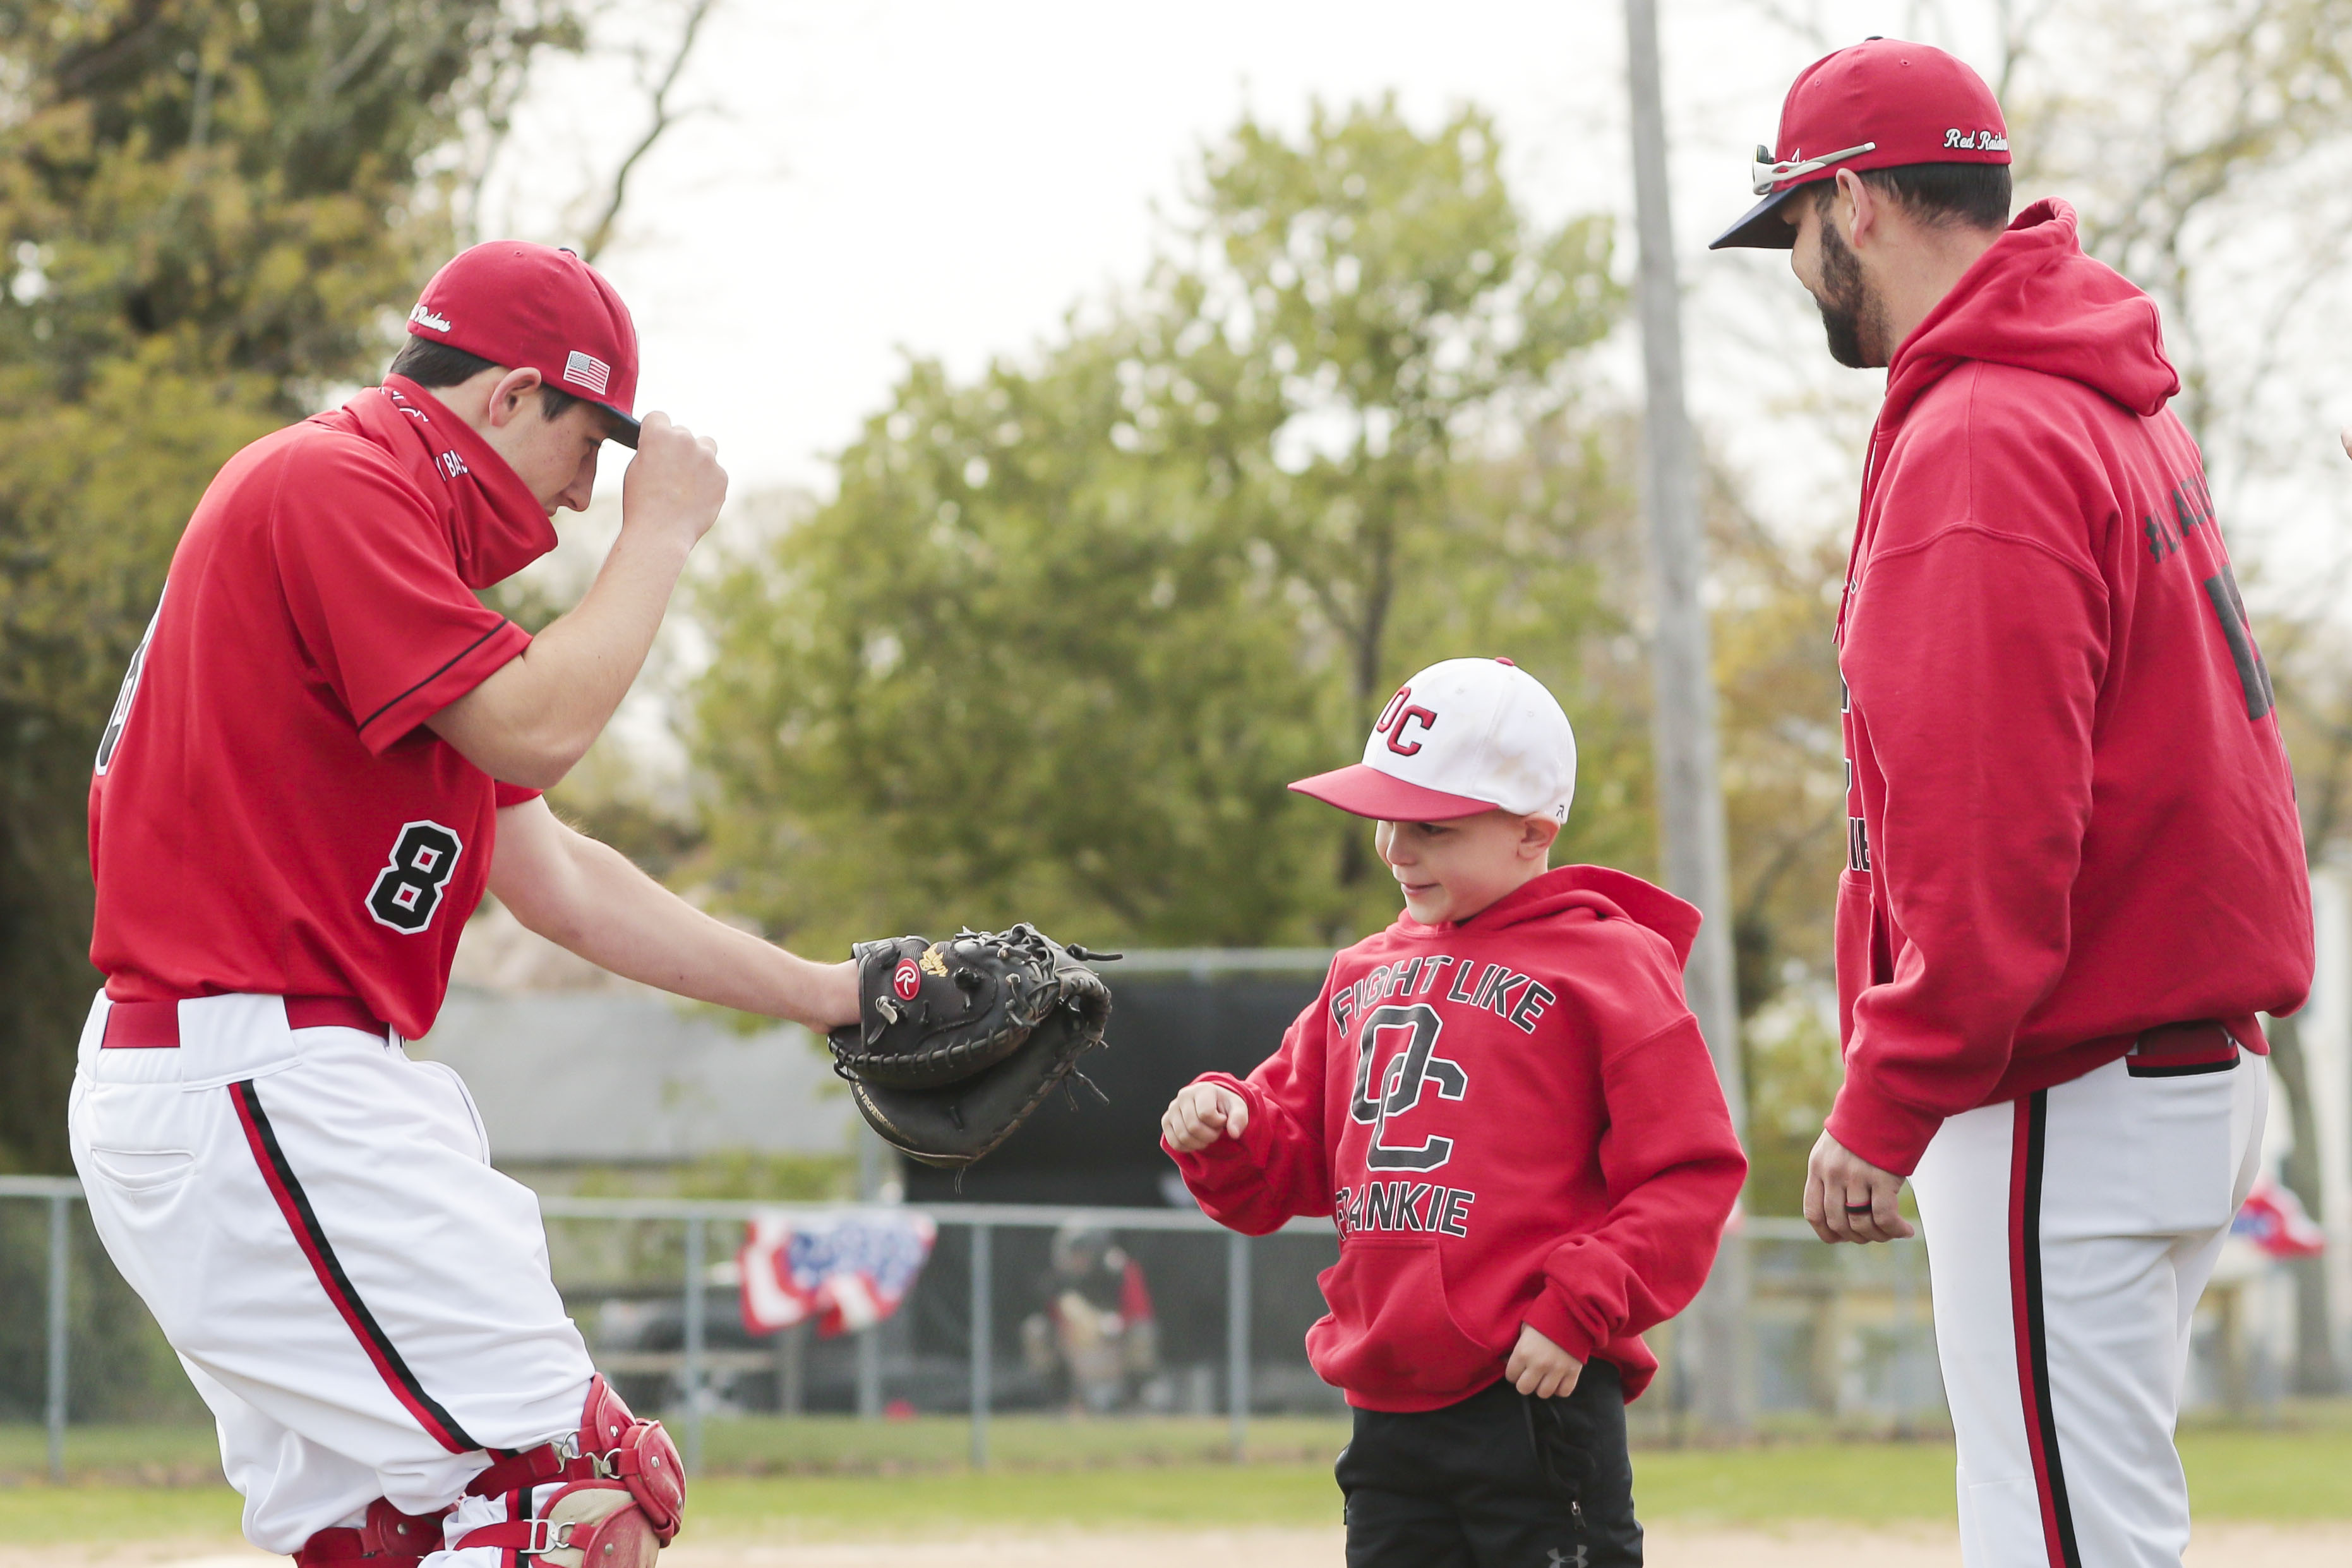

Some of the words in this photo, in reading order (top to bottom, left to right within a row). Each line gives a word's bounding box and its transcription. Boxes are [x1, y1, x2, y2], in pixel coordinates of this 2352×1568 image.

[1943, 128, 1975, 150] Red
[364, 819, 463, 935] 8
[1330, 955, 1453, 1039] FIGHT
[1447, 960, 1556, 1035] LIKE
